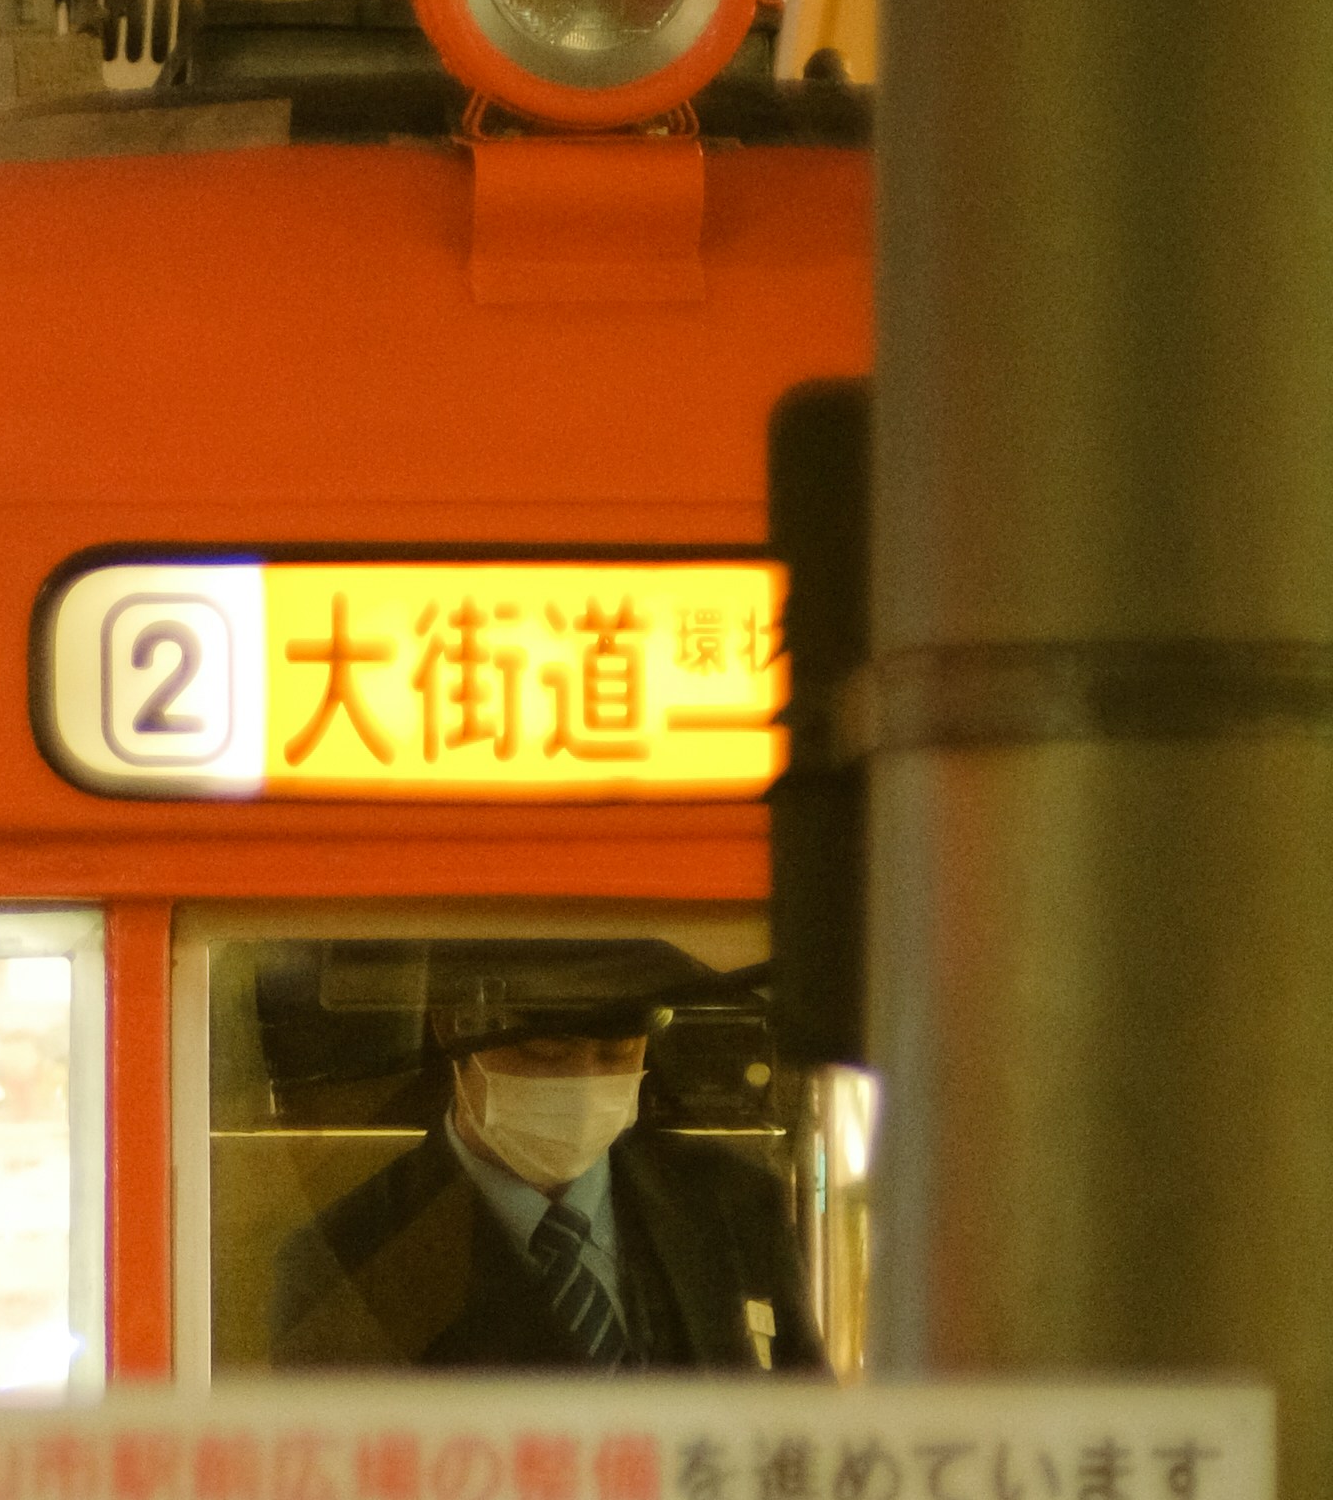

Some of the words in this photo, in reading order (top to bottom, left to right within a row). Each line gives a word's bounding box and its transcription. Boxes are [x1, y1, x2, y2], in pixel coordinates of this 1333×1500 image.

[131, 619, 205, 733] 2
[284, 590, 651, 767] 大街道
